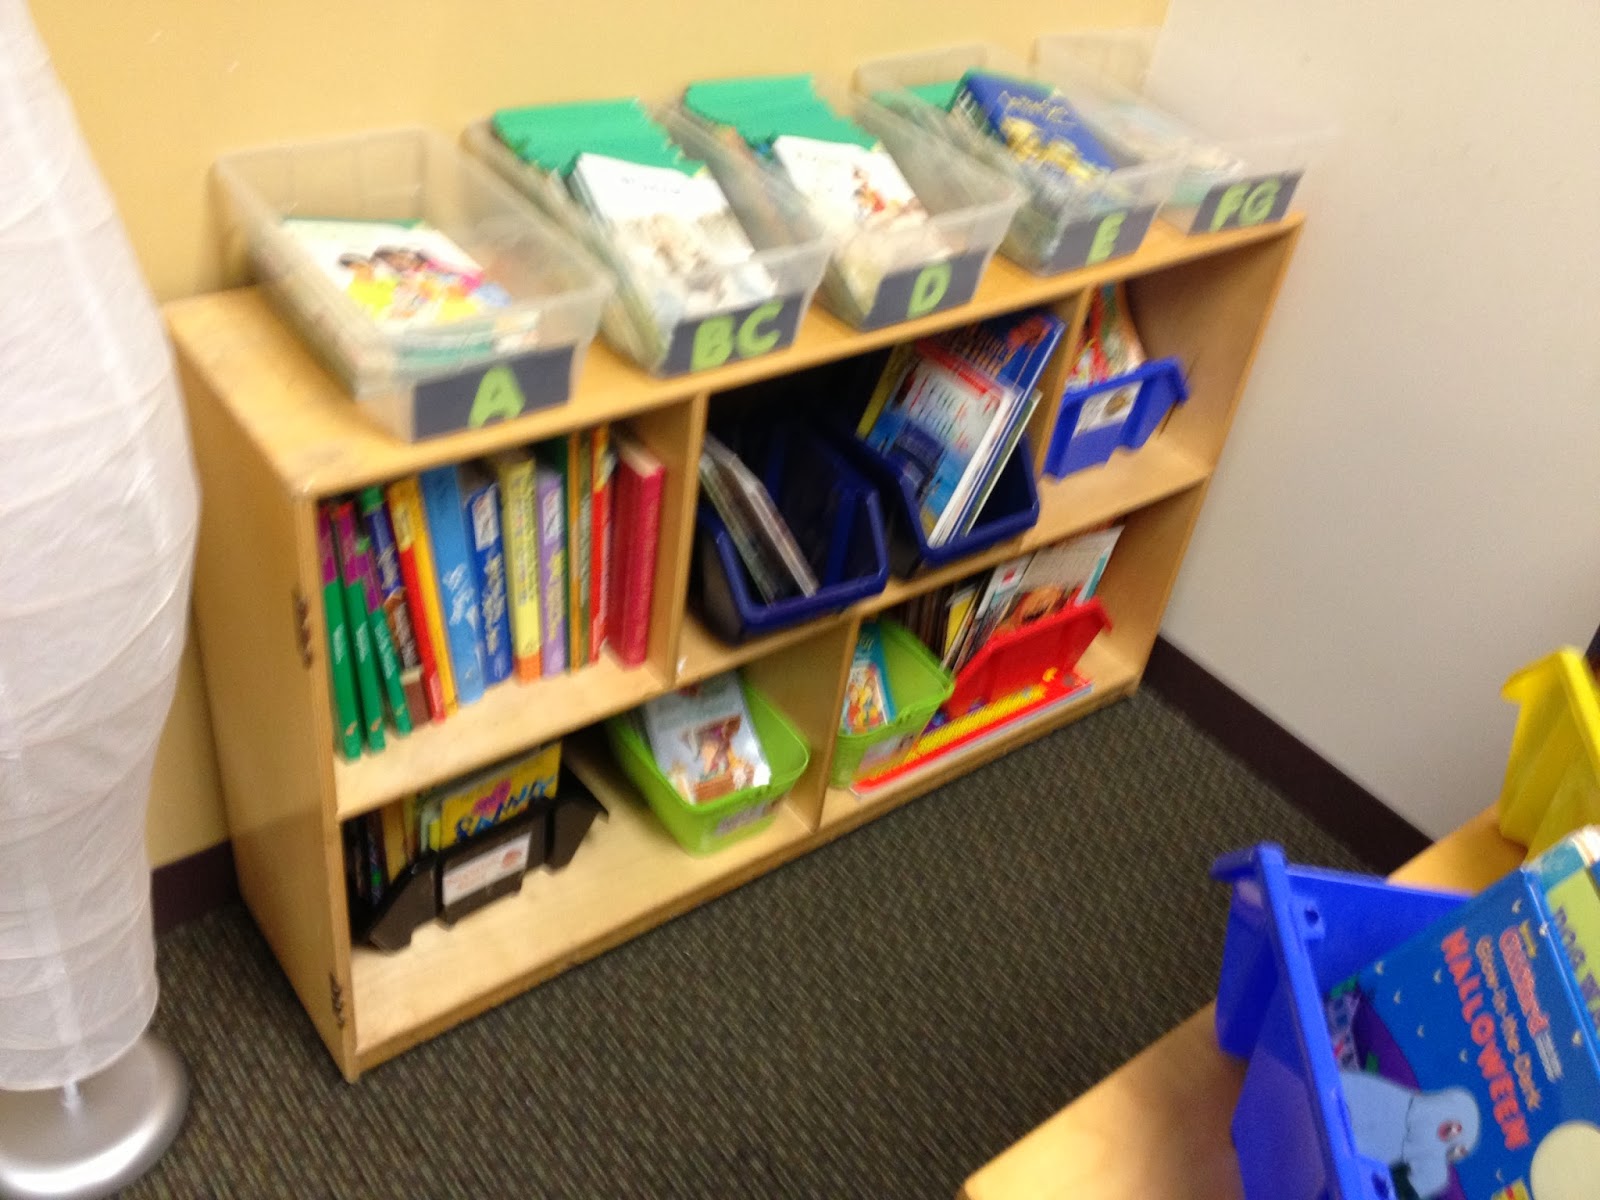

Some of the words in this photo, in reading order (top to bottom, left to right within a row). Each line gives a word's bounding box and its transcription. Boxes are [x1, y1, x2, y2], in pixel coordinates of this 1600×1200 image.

[1087, 212, 1126, 266] E
[907, 264, 950, 319] D
[691, 301, 785, 372] BC
[468, 366, 525, 429] A
[1442, 927, 1530, 1150] HALLOWEEN
